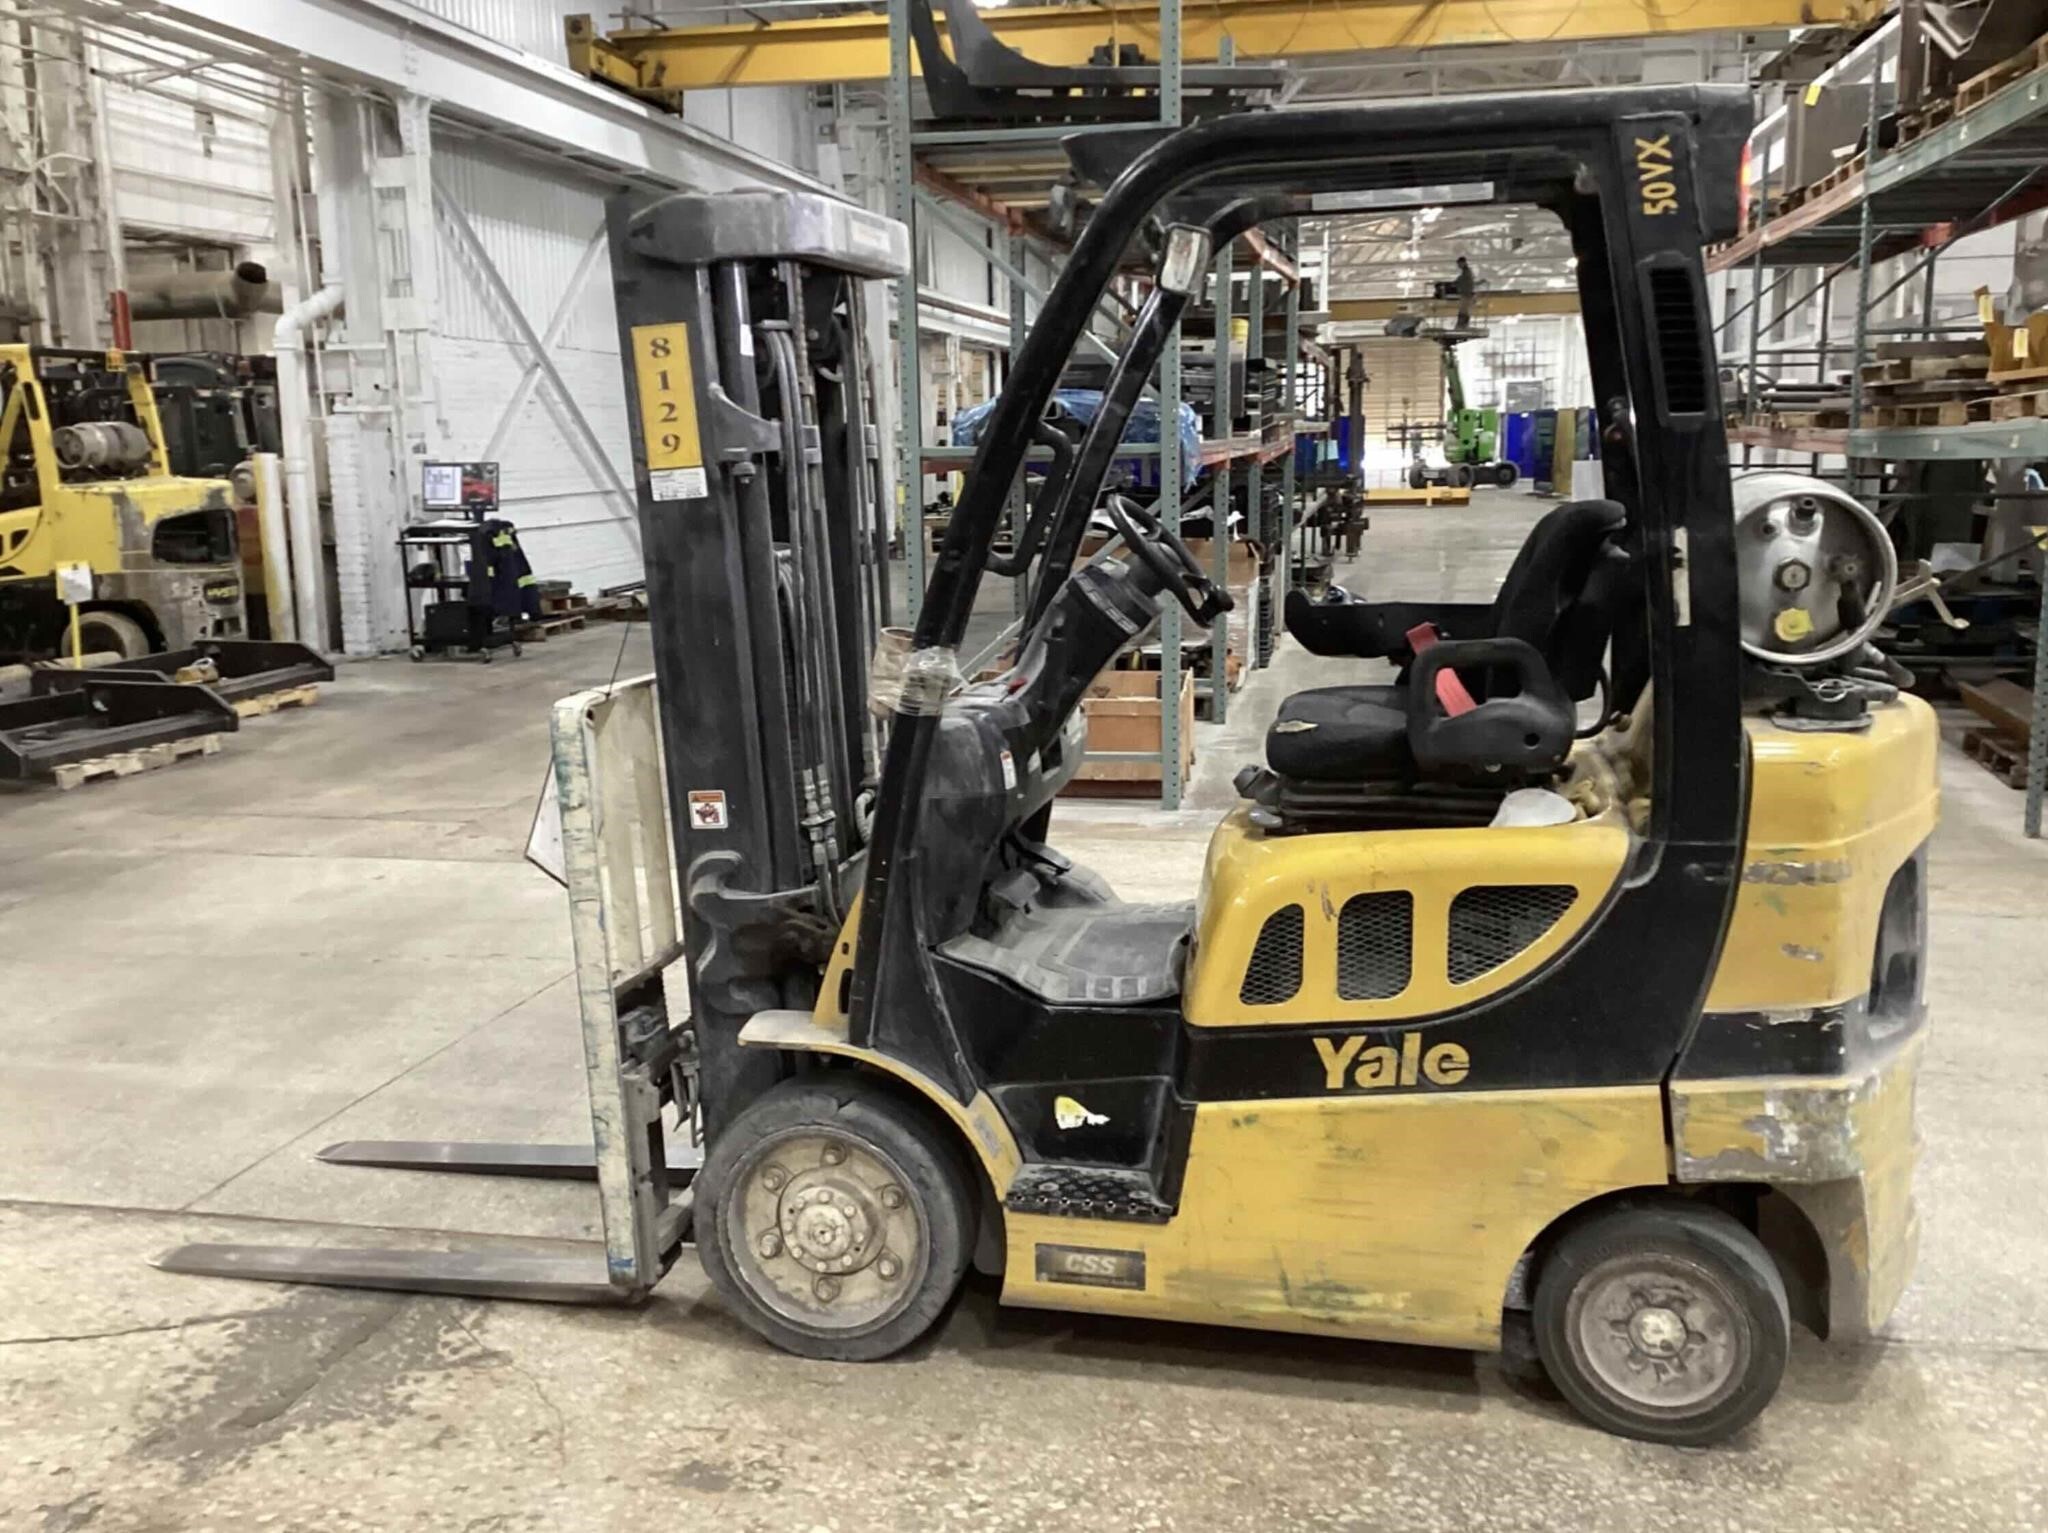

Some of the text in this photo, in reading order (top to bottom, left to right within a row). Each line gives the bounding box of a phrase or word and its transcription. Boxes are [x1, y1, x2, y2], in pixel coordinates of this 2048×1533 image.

[1635, 134, 1678, 215] 50VX
[649, 336, 681, 454] 8129
[1312, 1032, 1470, 1089] Yale
[1064, 1253, 1118, 1275] CSS
